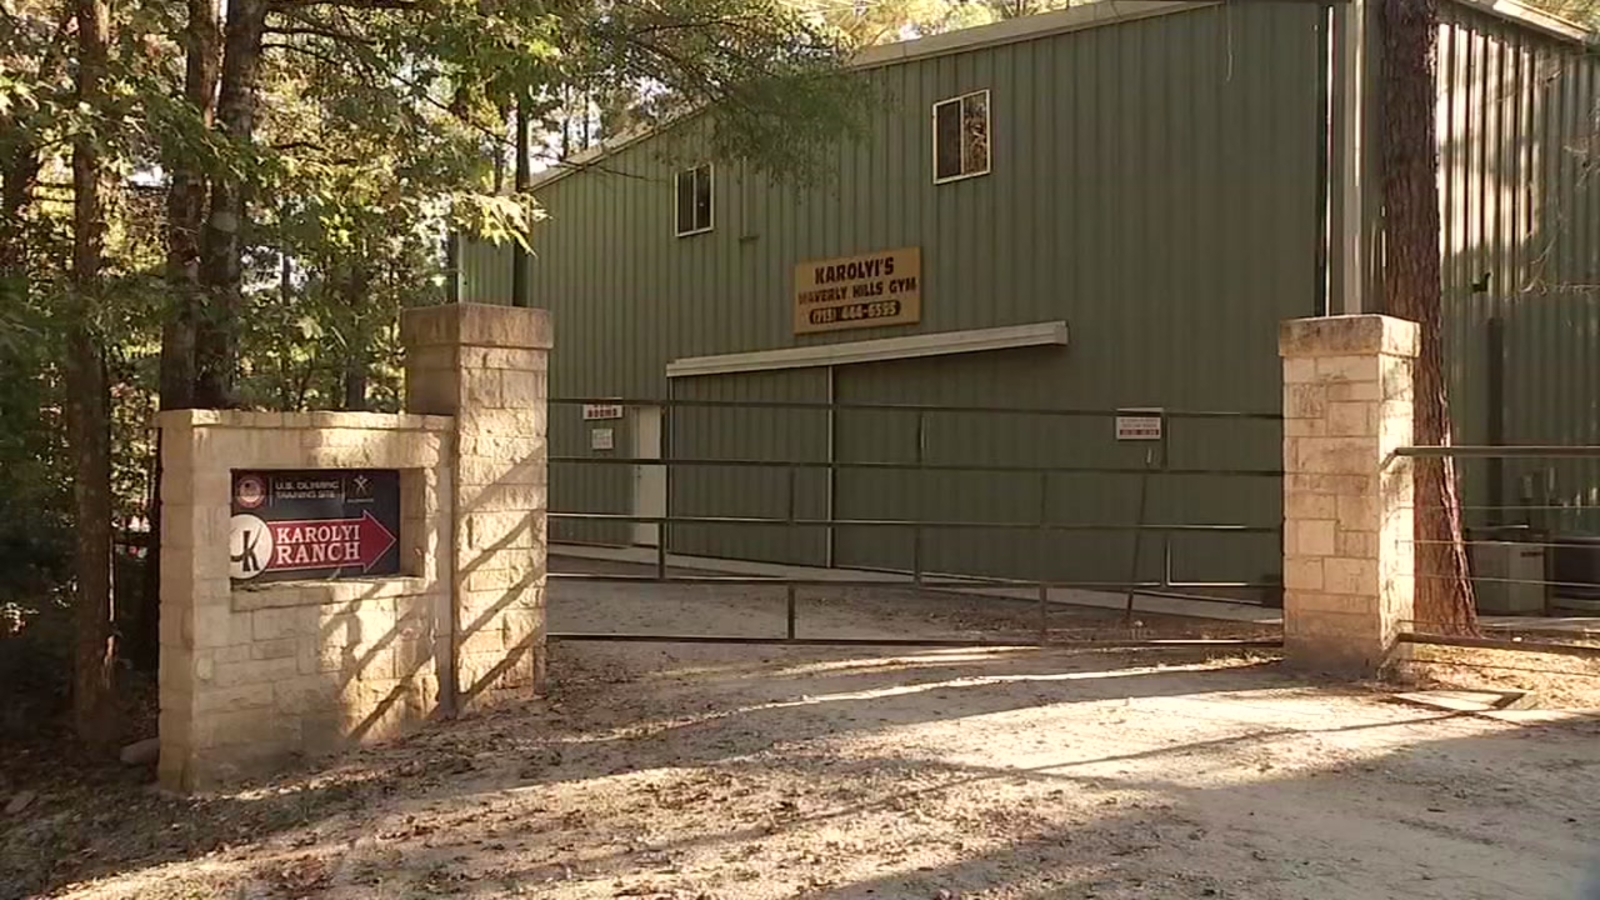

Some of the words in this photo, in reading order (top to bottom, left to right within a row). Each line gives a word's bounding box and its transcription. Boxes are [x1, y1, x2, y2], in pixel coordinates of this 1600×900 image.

[814, 256, 894, 285] KAROLYI'S
[798, 286, 848, 305] WAVERLY
[852, 281, 883, 299] HILLS
[889, 276, 917, 294] GYM
[276, 524, 361, 544] KAROLYI
[276, 542, 361, 565] RANCH
